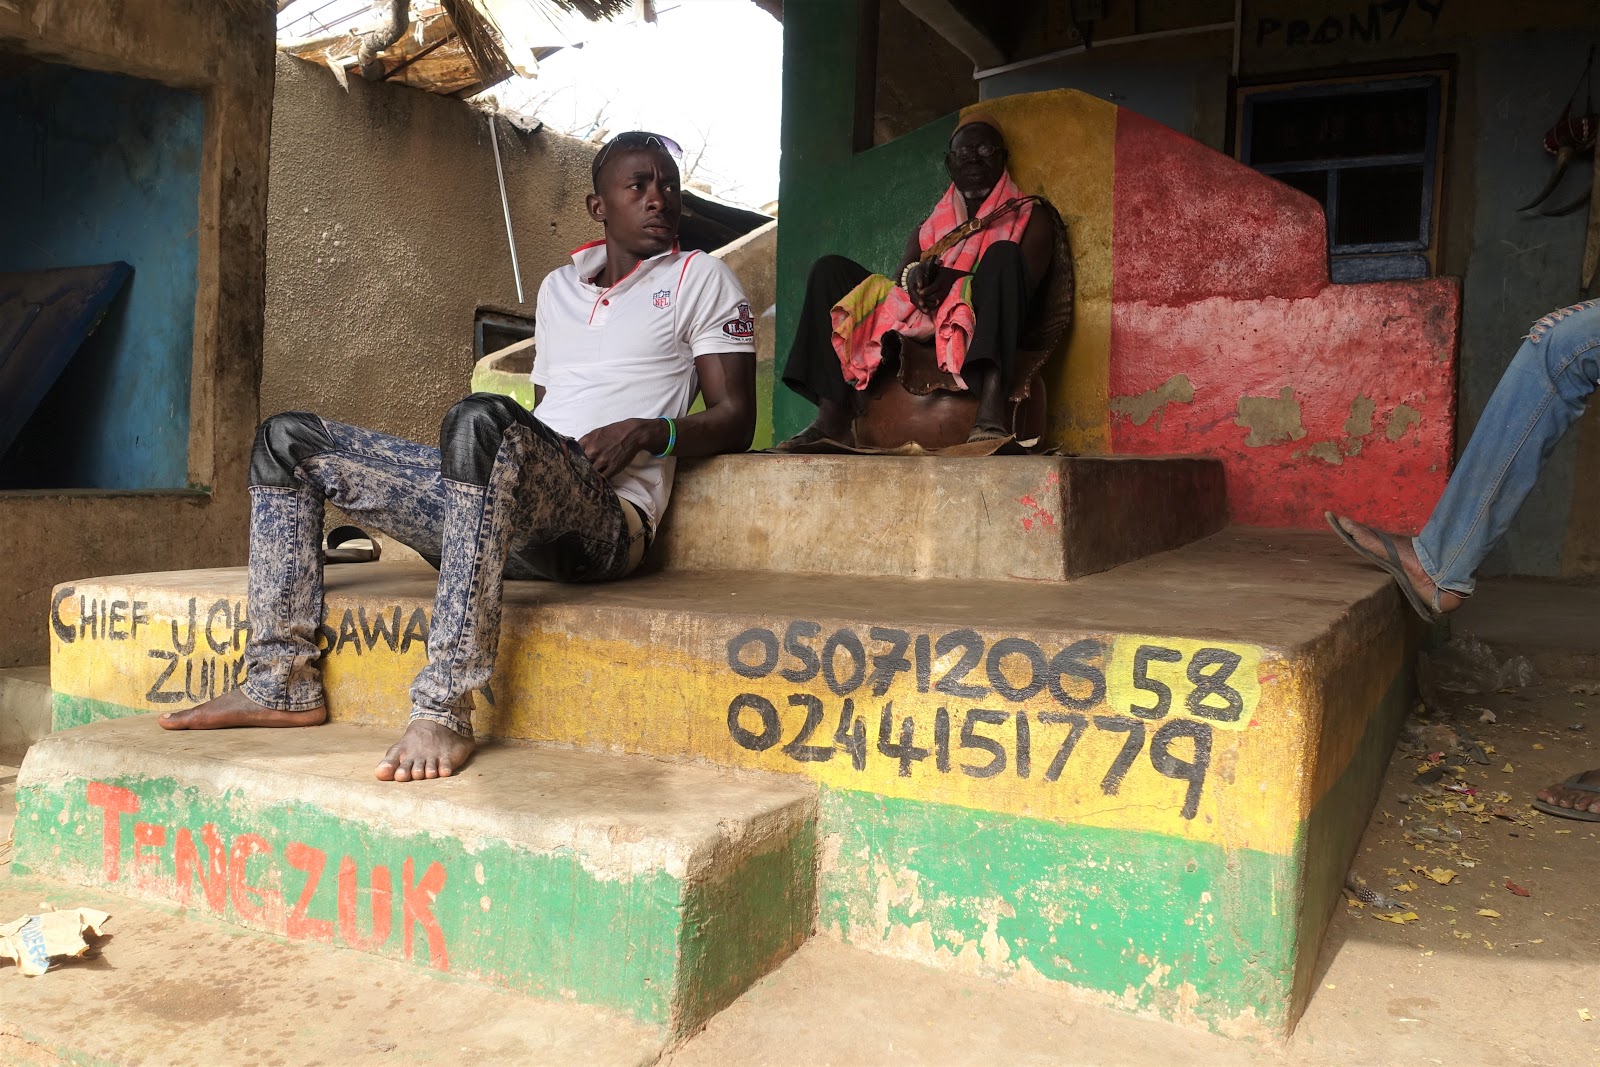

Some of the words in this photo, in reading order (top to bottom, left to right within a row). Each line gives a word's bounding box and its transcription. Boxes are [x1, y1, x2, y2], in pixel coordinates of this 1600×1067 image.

[655, 298, 669, 306] NFL
[51, 586, 149, 644] CHIEF
[727, 692, 1212, 820] 0244151779
